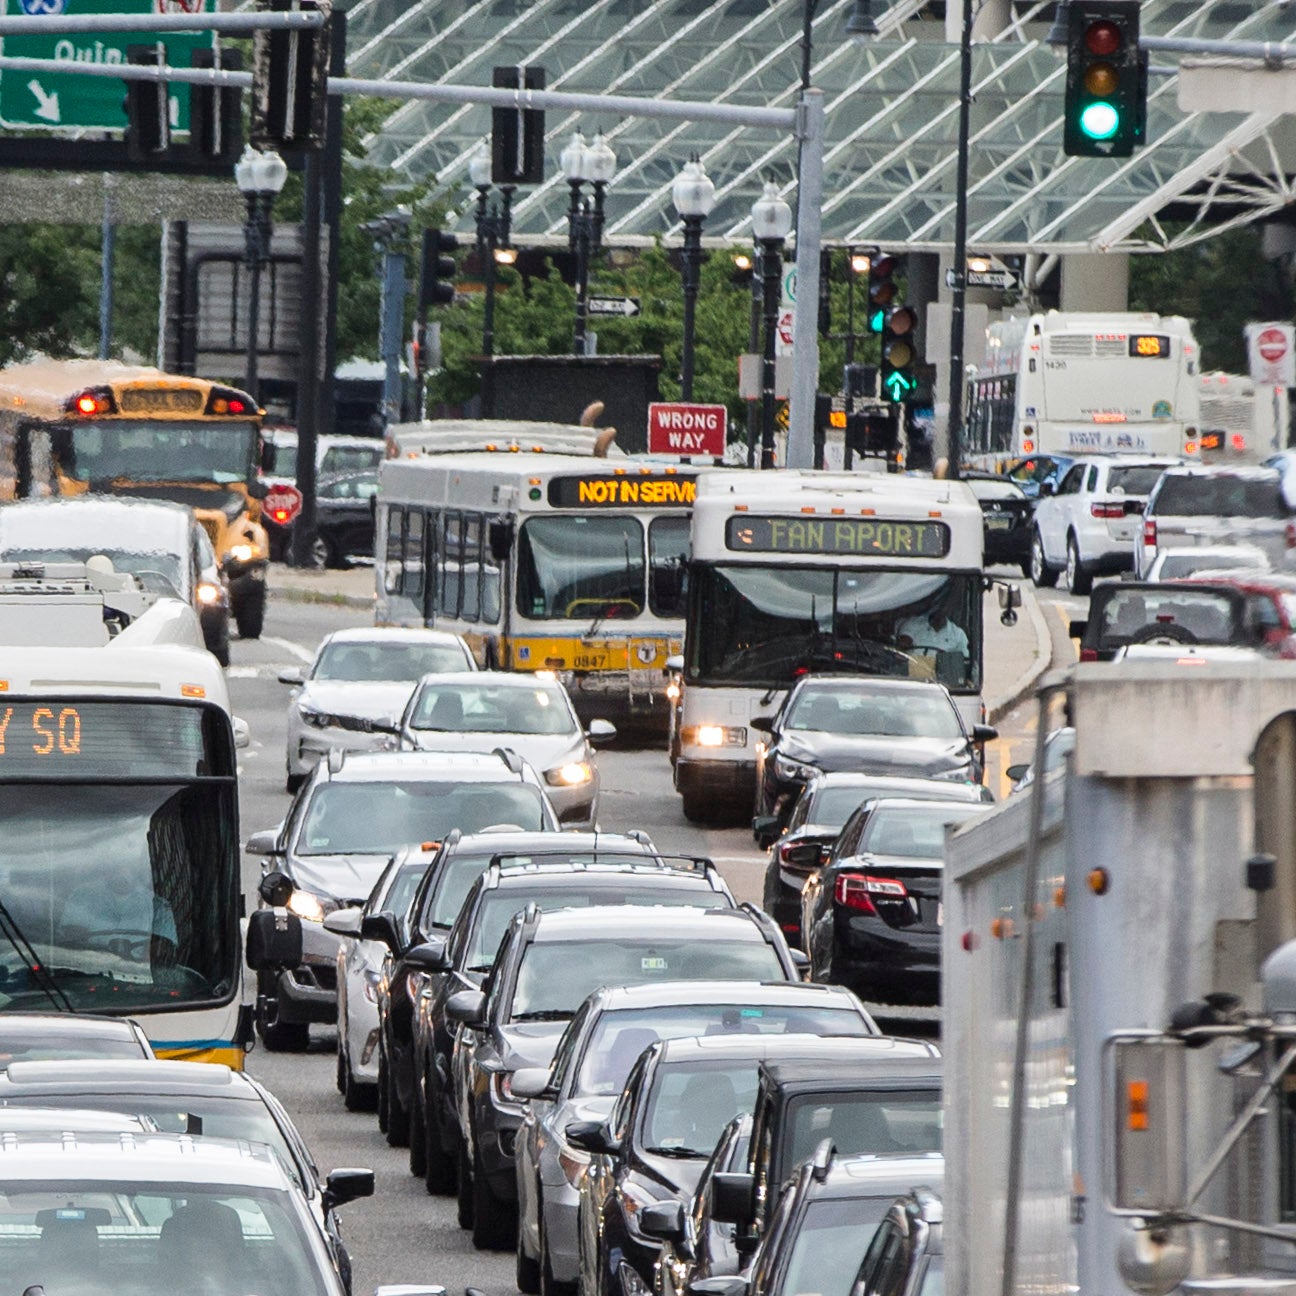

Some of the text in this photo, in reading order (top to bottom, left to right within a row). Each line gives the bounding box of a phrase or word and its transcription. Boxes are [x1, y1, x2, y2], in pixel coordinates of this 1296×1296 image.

[657, 410, 718, 429] WRONG
[668, 432, 704, 449] WAY
[579, 480, 618, 503] NOT
[620, 480, 639, 503] IN
[574, 656, 605, 668] 0847
[32, 707, 81, 755] SQ
